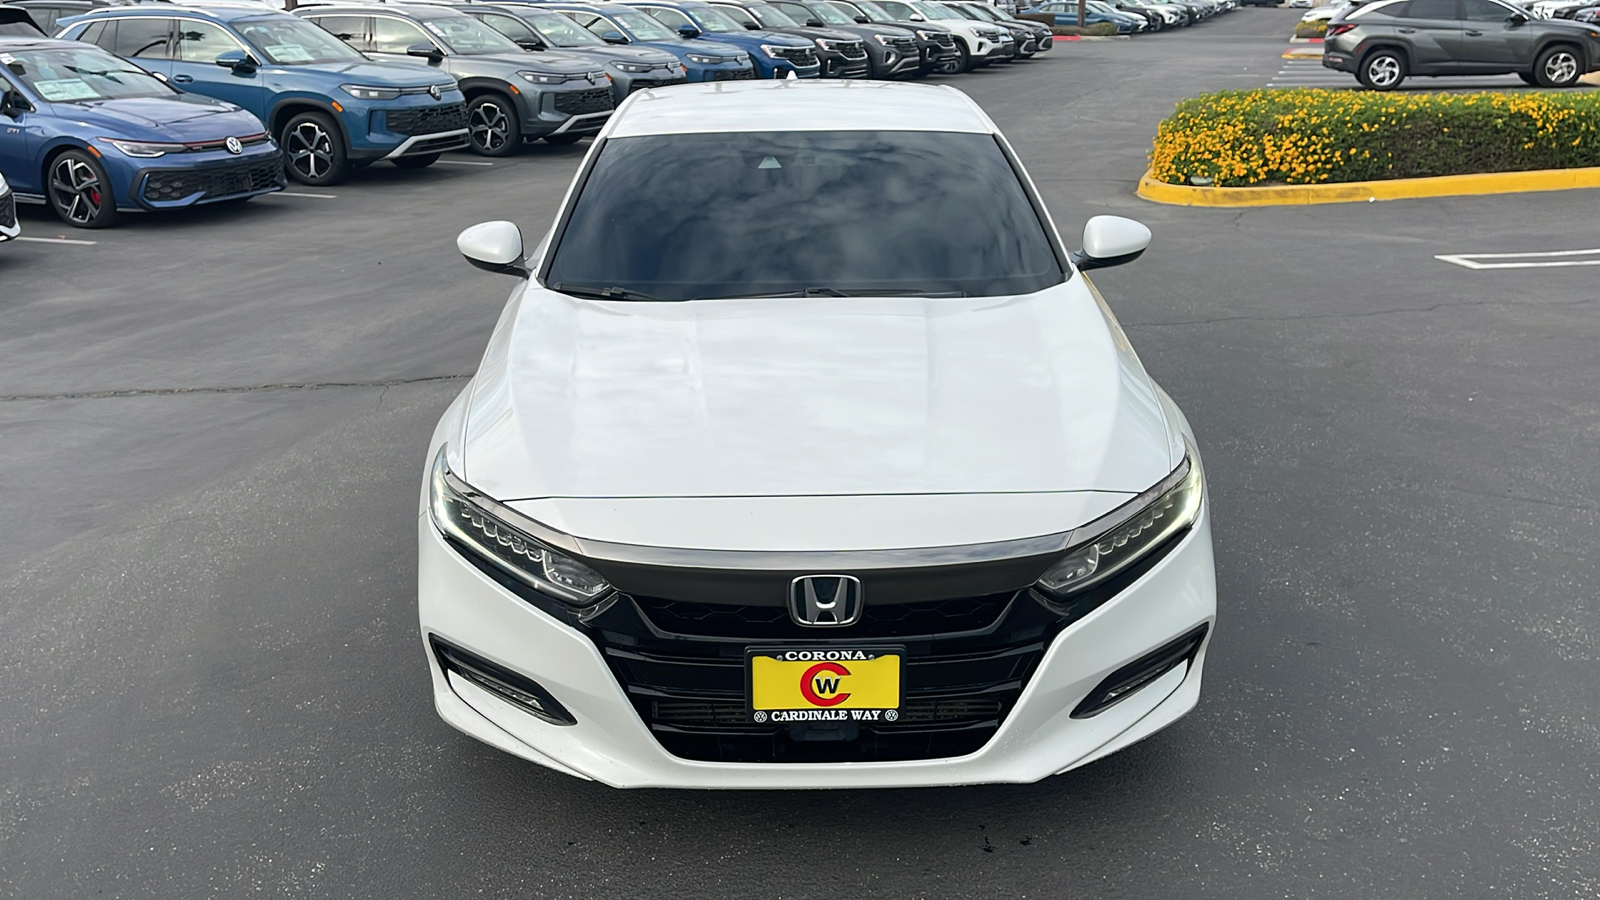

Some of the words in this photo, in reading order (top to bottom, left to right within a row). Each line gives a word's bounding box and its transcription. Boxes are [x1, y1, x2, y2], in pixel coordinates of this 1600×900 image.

[785, 651, 867, 661] CORONA
[800, 662, 852, 707] C
[815, 676, 841, 694] W
[771, 710, 848, 722] CARDINALE
[850, 710, 881, 721] WAY
